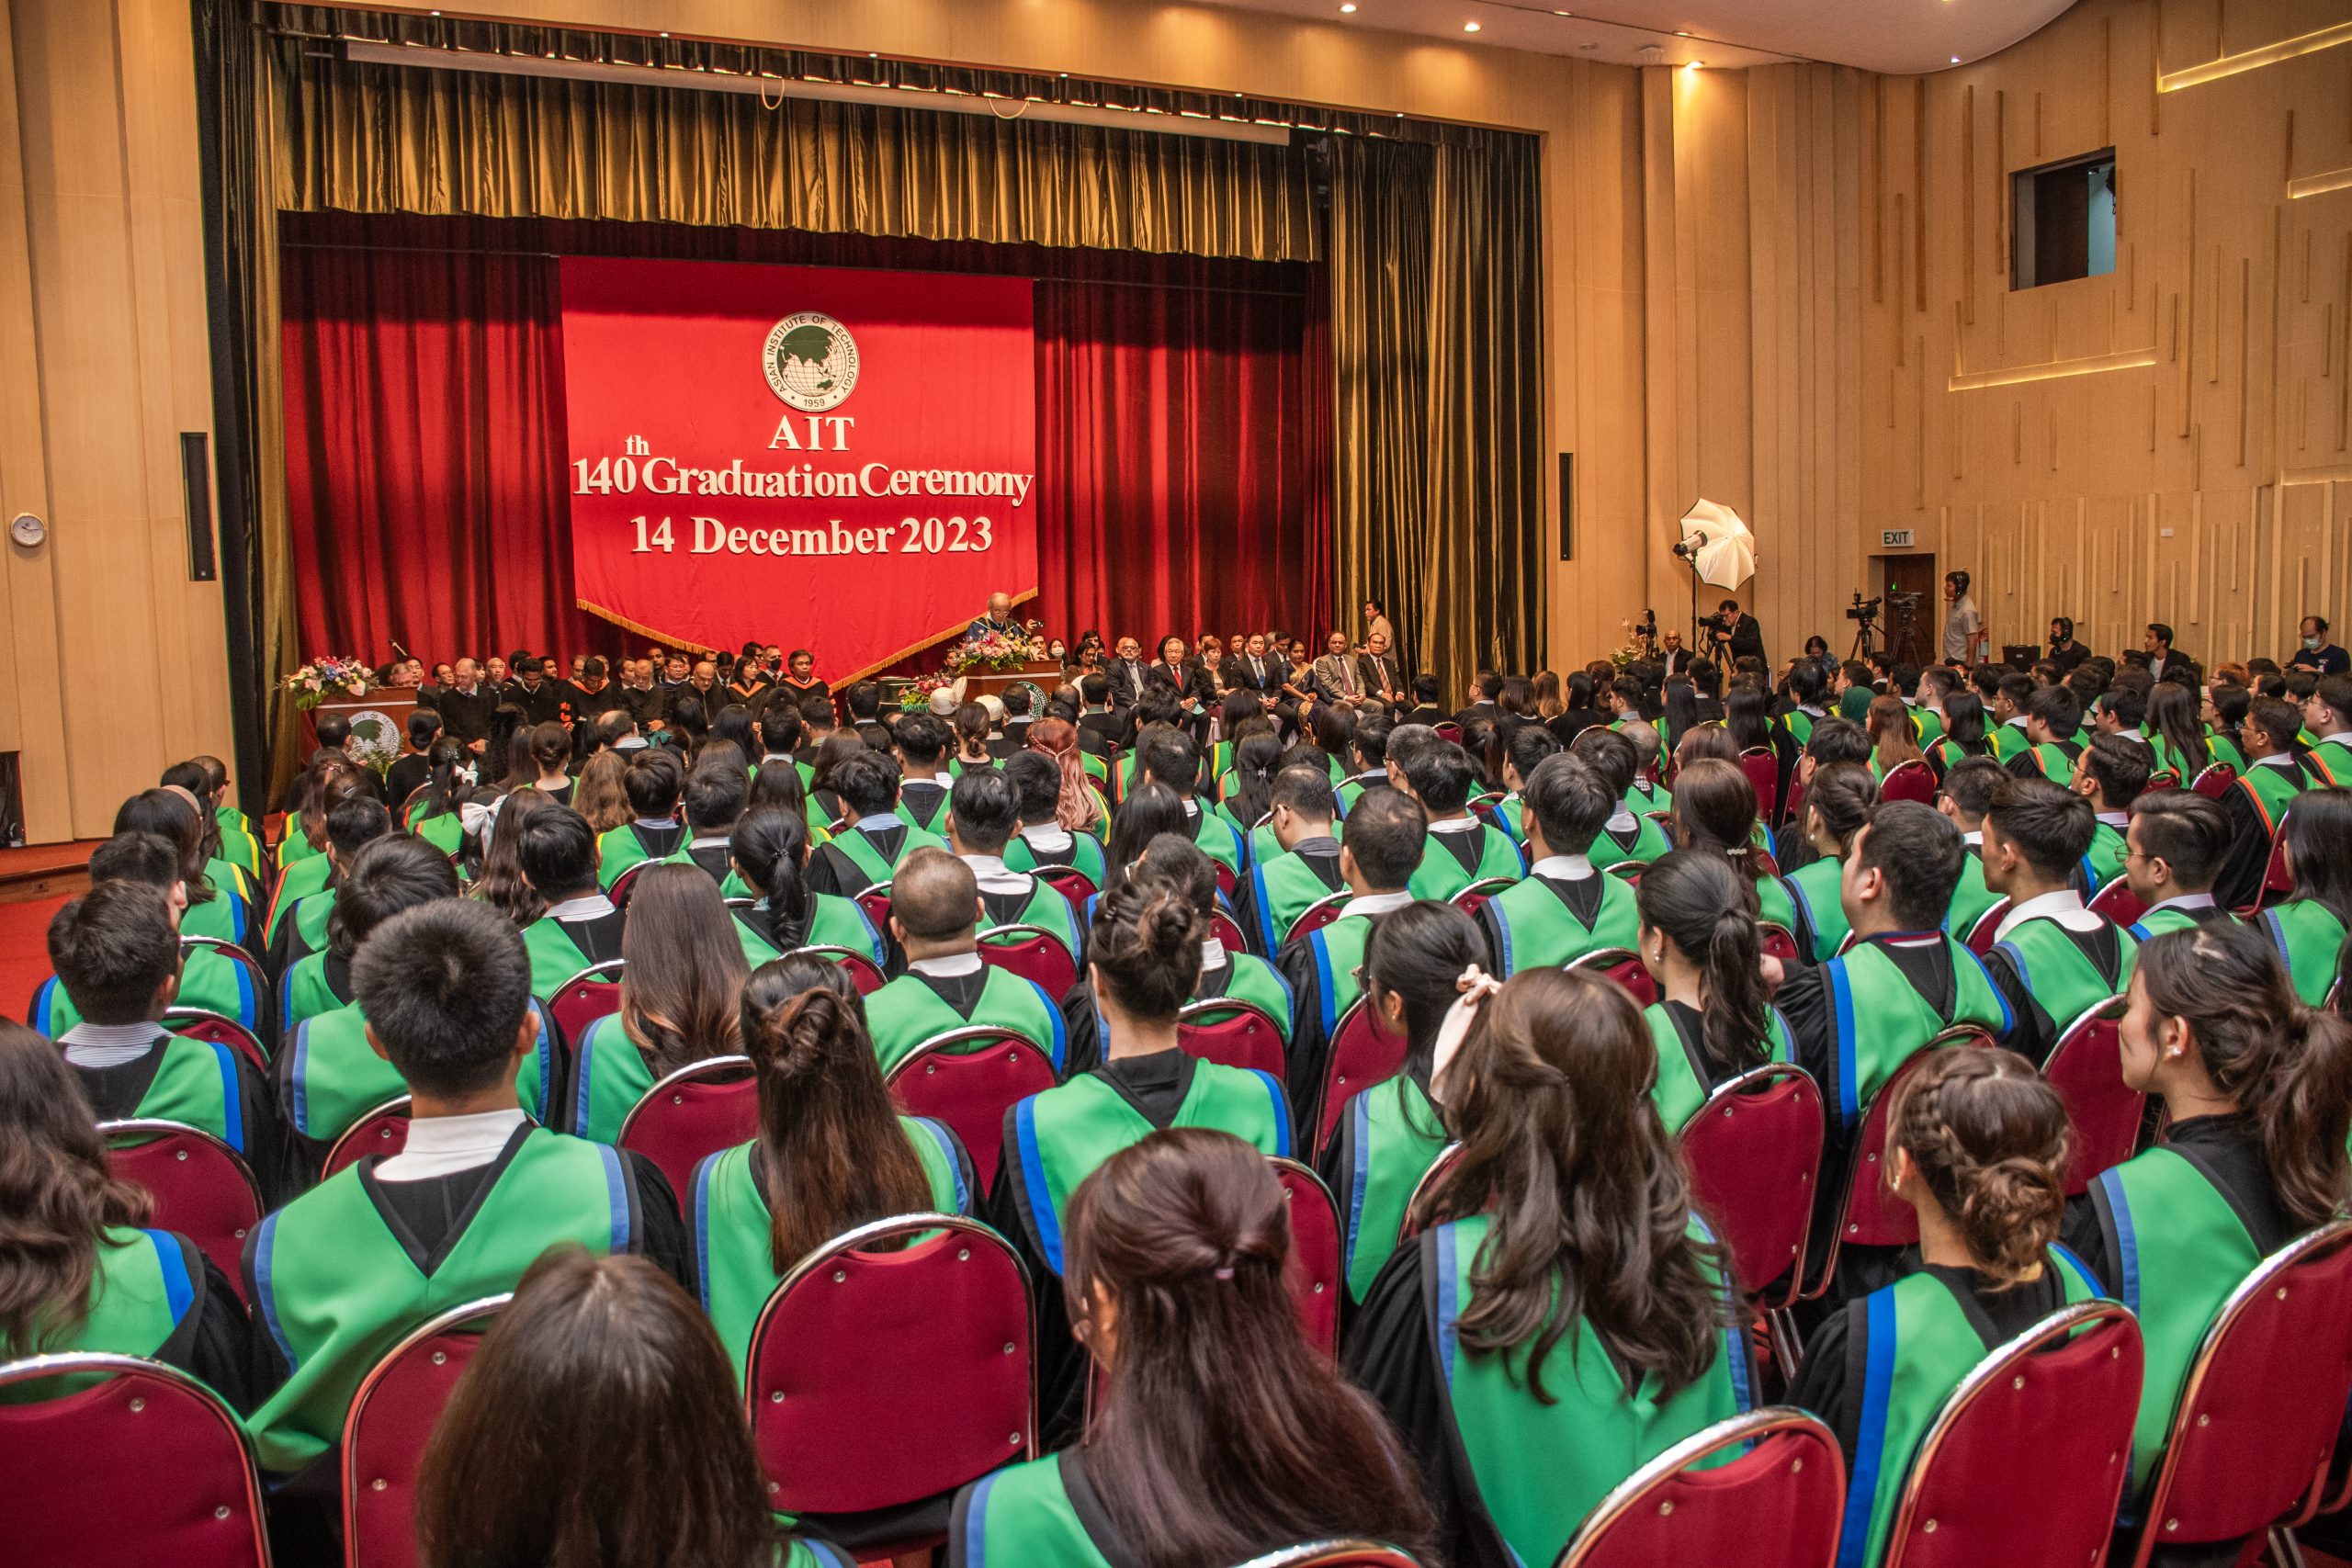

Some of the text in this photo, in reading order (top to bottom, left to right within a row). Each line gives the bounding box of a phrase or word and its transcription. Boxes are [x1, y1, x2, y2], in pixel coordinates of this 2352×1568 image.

[766, 315, 856, 394] ASIAN INSTITUTE OF TECHNOLOGY
[803, 399, 825, 408] 1959
[768, 414, 854, 451] AIT
[642, 457, 859, 498] Graduation
[858, 463, 1035, 507] Ceremony
[630, 516, 992, 555] 14 December 2023
[1883, 532, 1908, 544] EXIT
